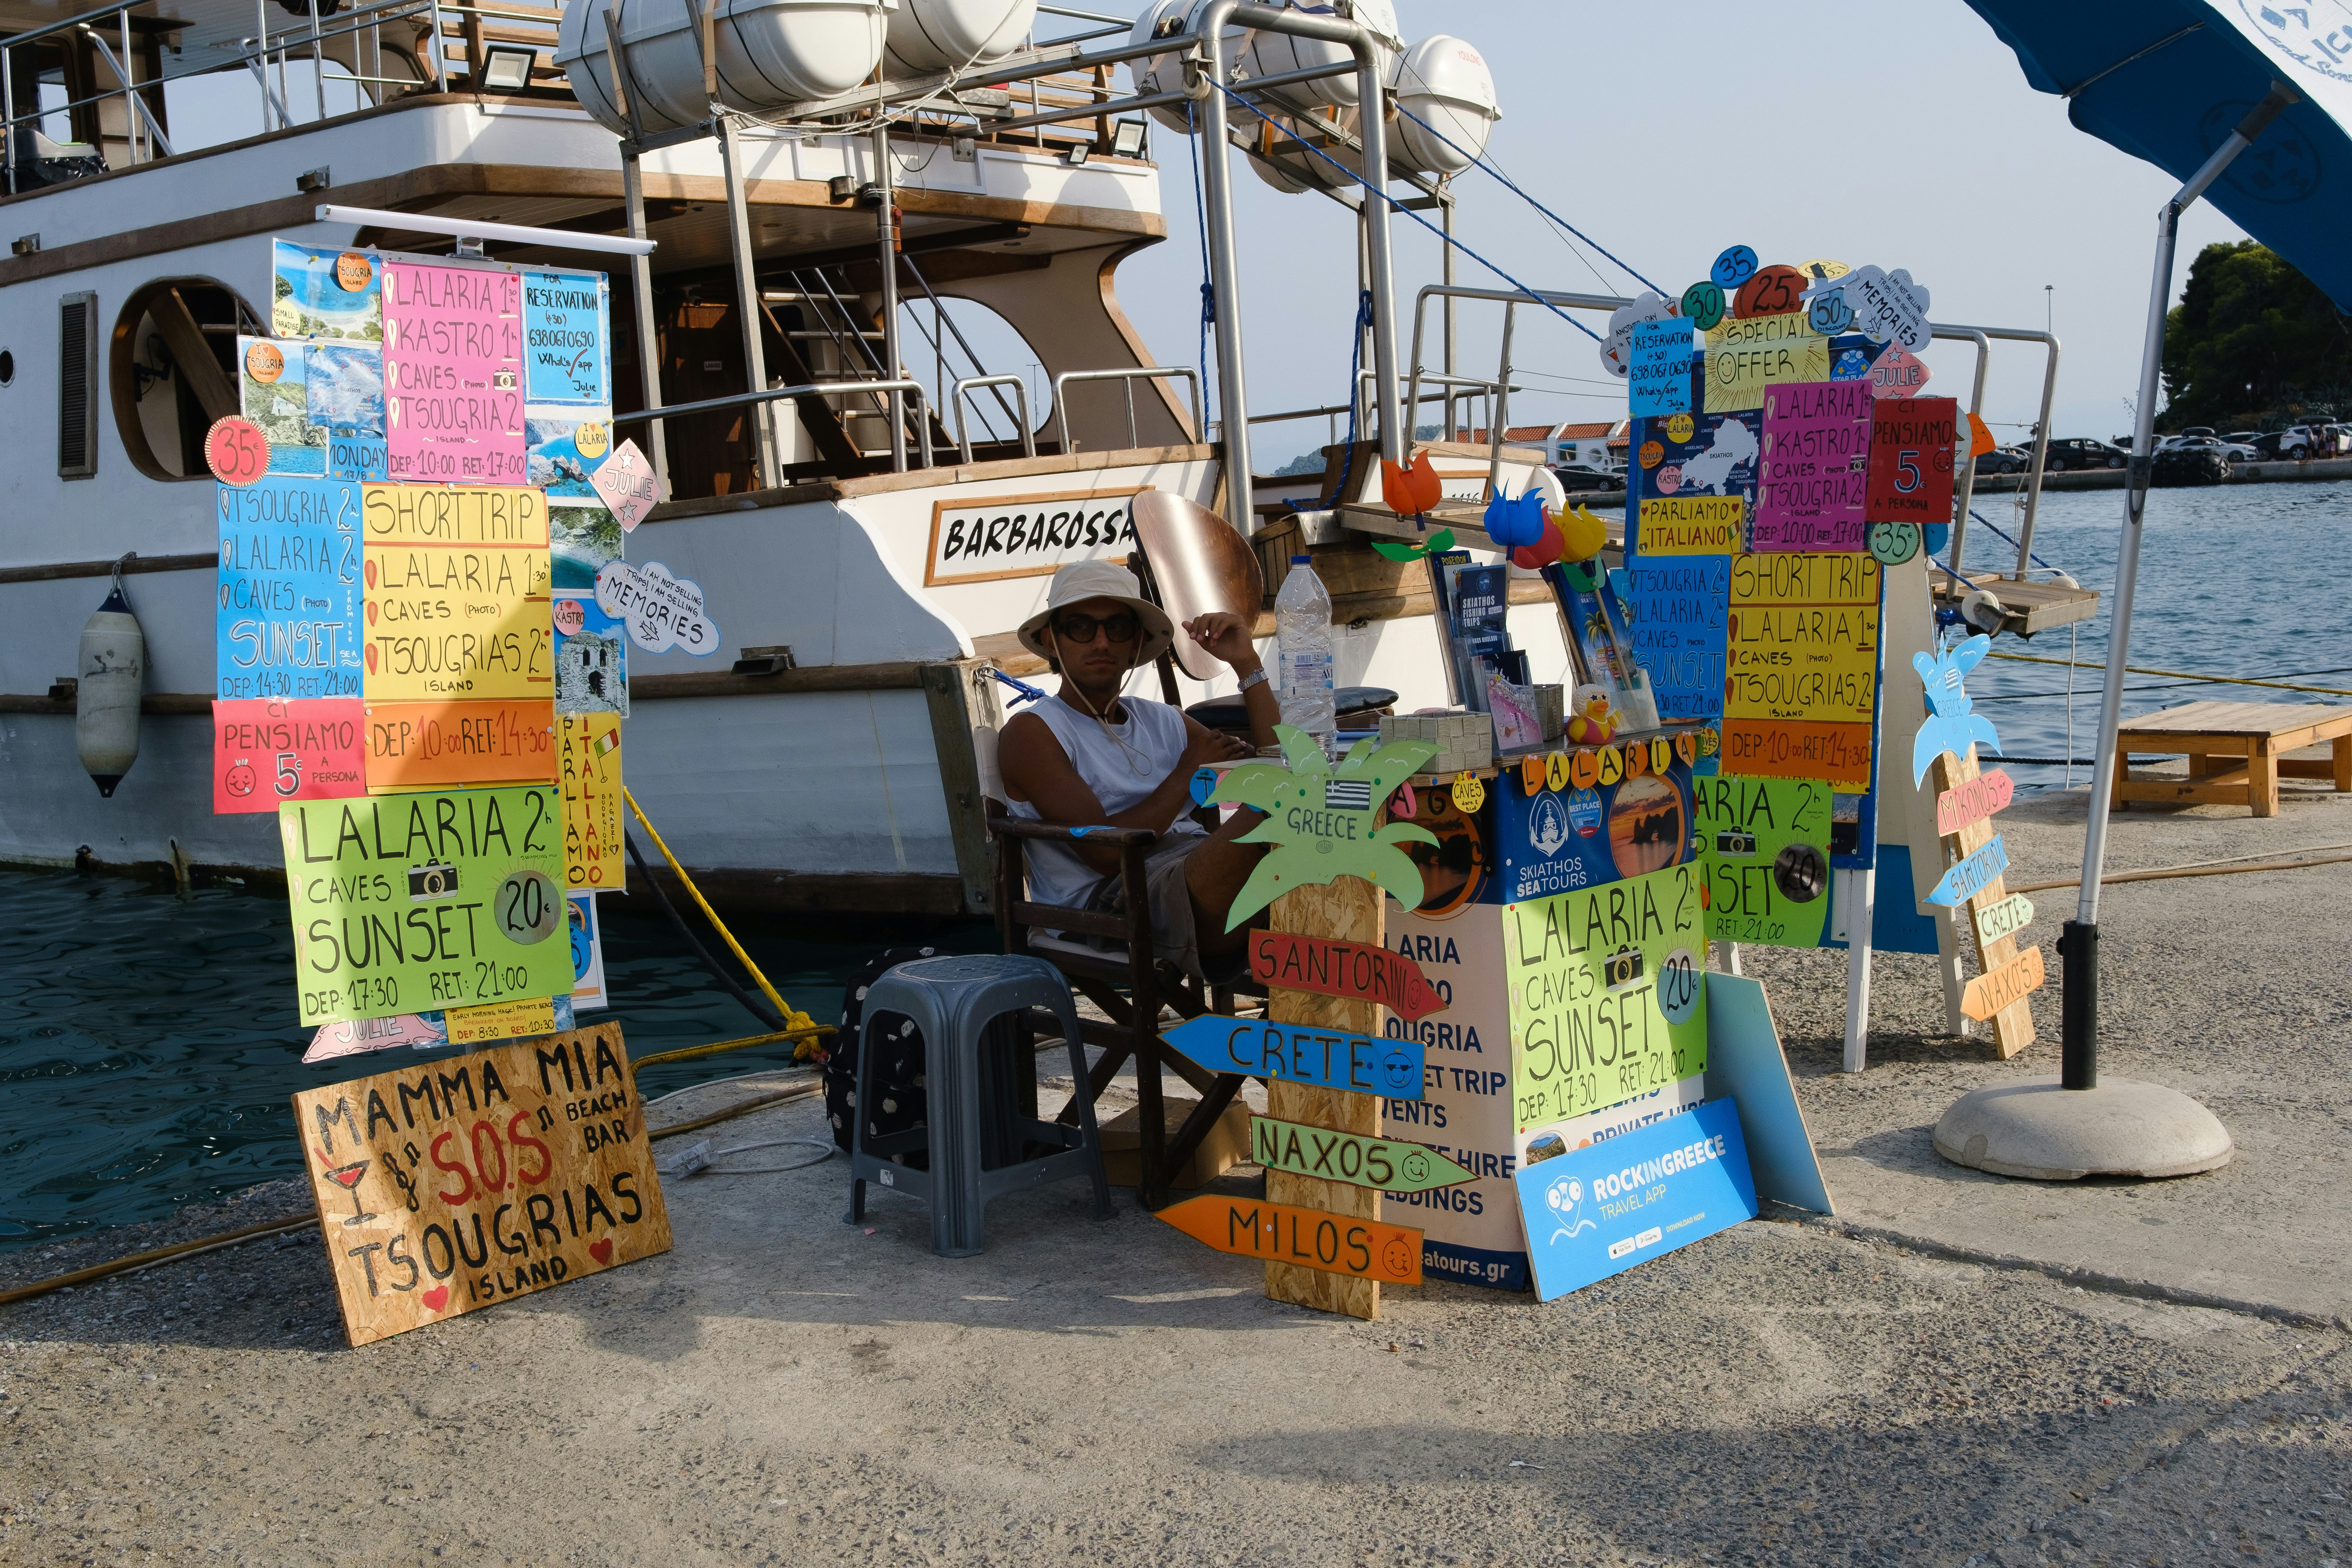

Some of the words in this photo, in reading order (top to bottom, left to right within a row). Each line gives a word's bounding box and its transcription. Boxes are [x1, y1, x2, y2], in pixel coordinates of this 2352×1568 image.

[1457, 50, 1481, 66] YOULONG
[338, 265, 372, 279] TSOUGRIA
[543, 274, 561, 284] FOR
[1892, 278, 1899, 286] AM
[1899, 286, 1908, 294] NOT
[396, 270, 493, 313] LALARIA
[527, 287, 598, 310] RESERVATION
[276, 308, 294, 319] SMALL
[276, 320, 299, 331] PARADISE
[1644, 313, 1658, 323] DAY
[1818, 323, 1846, 332] DISCOUNT
[1858, 280, 1917, 347] MEMORIES
[399, 318, 494, 358] KASTRO
[1635, 331, 1693, 352] RESERVATION
[1727, 316, 1814, 345] SPECIAL
[247, 356, 284, 369] TSOUGRIA
[399, 362, 456, 390] CAVES
[1873, 365, 1920, 387] JULIE
[399, 395, 504, 435] TSOUGRIA
[1777, 387, 1854, 419] LALARIA
[1898, 401, 1914, 413] CI
[436, 435, 466, 444] ISLAND
[577, 433, 608, 444] LALARIA
[1668, 424, 1694, 433] LALARIA
[1776, 427, 1849, 458] KASTRO
[1874, 420, 1952, 445] PENSIAMO
[417, 449, 455, 476] 10:00
[487, 450, 524, 477] 17:00
[1640, 452, 1663, 460] TSOUGRIA
[1773, 462, 1815, 479] CAVES
[604, 469, 654, 501] JULIE
[1658, 474, 1681, 485] KASTRO
[229, 488, 332, 528] TSOUGRIA
[1767, 479, 1848, 510] TSOUGRIA
[1888, 498, 1928, 511] PERSONA
[365, 490, 466, 540] SHORT
[471, 492, 533, 541] TRIP
[1650, 502, 1729, 522] PARLIAMO
[1650, 527, 1726, 548] ITALIANO
[1781, 521, 1815, 544] 10:00
[1833, 521, 1863, 543] 17:00
[235, 534, 331, 574] LALARIA
[382, 553, 514, 596] LALARIA
[649, 571, 659, 582] AM
[661, 578, 675, 589] NOT
[674, 585, 702, 606] SELLING
[1636, 568, 1707, 593] TSOUGRIA
[1733, 554, 1818, 598] SHORT
[1824, 555, 1877, 599] TRIP
[235, 578, 295, 611] CAVES
[655, 587, 665, 597] AM
[667, 594, 698, 618] SELLING
[1463, 595, 1495, 609] SKIATHOS
[384, 599, 451, 622] CAVES
[555, 611, 585, 625] KASTRO
[606, 576, 703, 645] MEMORIES
[1463, 607, 1486, 618] FISHING
[1464, 617, 1480, 628] TRIPS
[1638, 598, 1704, 623] LALARIA
[1637, 630, 1678, 648] CAVES
[1741, 611, 1851, 645] LALARIA
[230, 620, 344, 668] SUNSET
[376, 633, 521, 675] TSOUGRIAS
[1739, 651, 1792, 666] CAVES
[256, 672, 291, 697] 14:30
[324, 670, 357, 696] 21:00
[425, 680, 473, 691] ISLAND
[1635, 652, 1722, 690] SUNSET
[1692, 693, 1719, 714] 21:00
[1734, 673, 1856, 707] TSOUGRIAS
[268, 703, 287, 718] CI
[1769, 709, 1804, 718] ISLAND
[1937, 699, 1963, 719] GREECE
[225, 721, 353, 751] PENSIAMO
[416, 714, 461, 760] 10:00
[496, 710, 548, 757] 14:30
[1767, 730, 1802, 764] 10:00
[1827, 732, 1868, 769] 14:30
[313, 771, 359, 783] PERSONA
[1454, 783, 1481, 799] CAVES
[563, 716, 585, 884] PARLIAMO
[1583, 801, 1600, 810] PLACE
[1940, 779, 1998, 830] MIKONOS
[300, 796, 512, 863] LALARIA
[1287, 806, 1357, 840] GREECE
[1520, 857, 1582, 881] SKIATHOS
[1951, 838, 2003, 901] SANTORINI
[308, 874, 392, 904] CAVES
[1517, 871, 1587, 898] SEATOURS
[1516, 880, 1663, 966] LALARIA
[1743, 918, 1784, 940] 21:00
[1981, 897, 2023, 938] CRETE
[309, 903, 483, 973] SUNSET
[347, 976, 398, 1011] 17:30
[476, 961, 527, 999] 21:00
[1259, 938, 1406, 1010] SANTORINI
[1526, 964, 1595, 1011] CAVES
[1979, 958, 2032, 1016] NAXOS
[479, 1026, 499, 1038] 8:30
[529, 1019, 555, 1032] 10:30
[1525, 984, 1652, 1081] SUNSET
[1228, 1026, 1373, 1089] CRETE
[315, 1060, 509, 1155] MAMMA
[536, 1035, 623, 1096] MIA
[1450, 1068, 1506, 1095] TRIP
[1553, 1072, 1596, 1116] 17:30
[1650, 1048, 1685, 1085] 21:00
[566, 1089, 628, 1122] BEACH
[584, 1120, 630, 1153] BAR
[1260, 1122, 1395, 1186] NAXOS
[1458, 1149, 1516, 1179] HIRE
[1593, 1134, 1726, 1203] ROCKINGREECE
[1599, 1197, 1643, 1221] TRAVEL
[1645, 1184, 1666, 1205] APP
[348, 1171, 643, 1298] TSOUGRIAS
[1665, 1217, 1693, 1233] DOWNLOAD
[1694, 1212, 1705, 1221] NOW
[1229, 1205, 1371, 1273] MILOS
[469, 1255, 568, 1302] ISLAND
